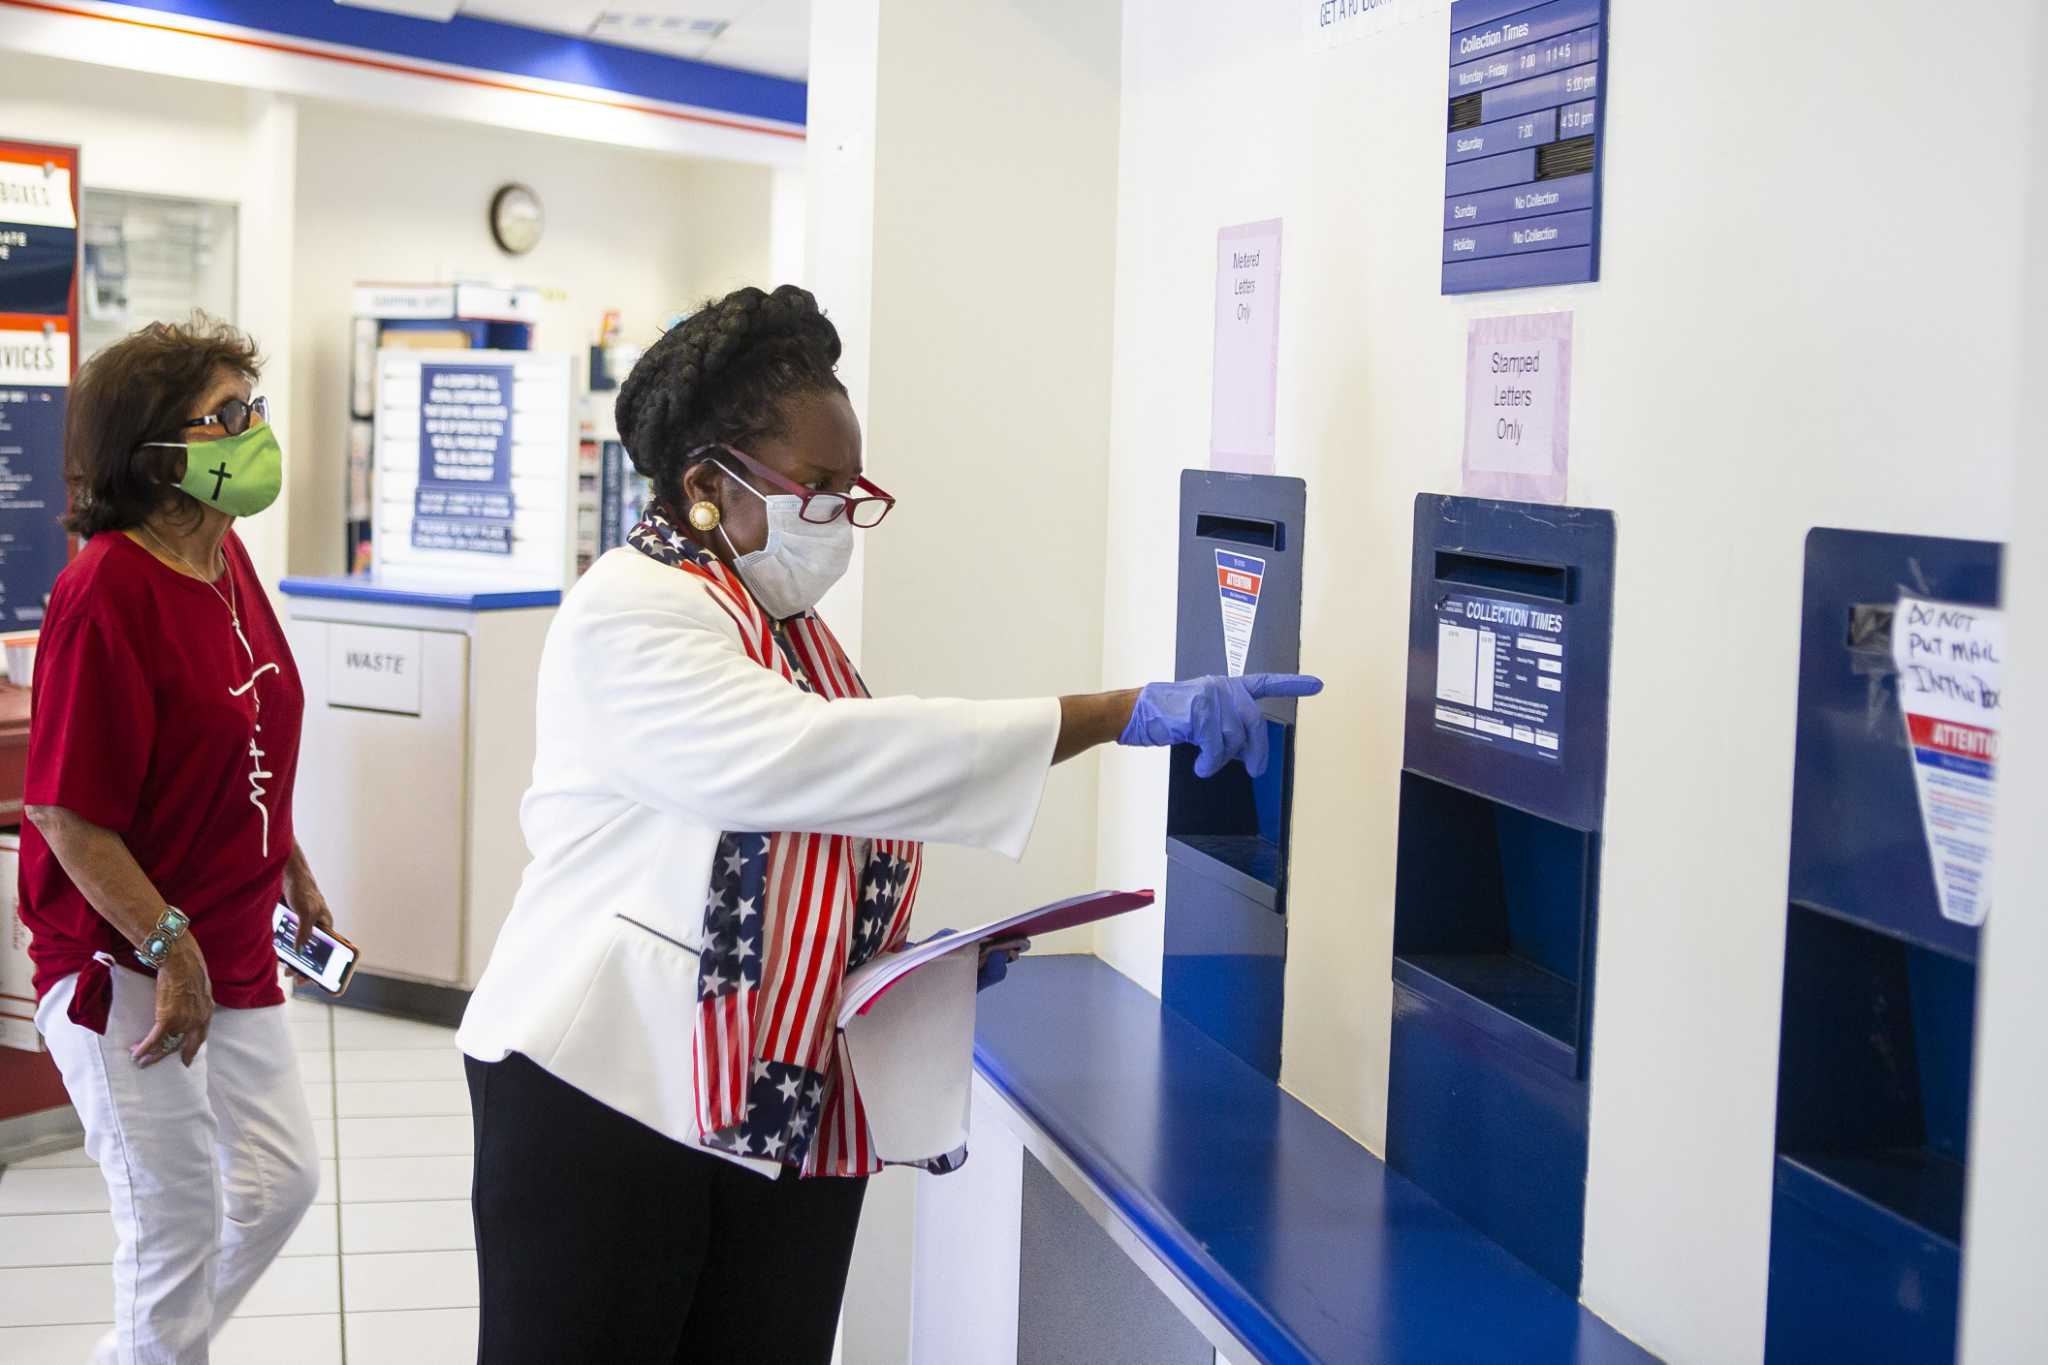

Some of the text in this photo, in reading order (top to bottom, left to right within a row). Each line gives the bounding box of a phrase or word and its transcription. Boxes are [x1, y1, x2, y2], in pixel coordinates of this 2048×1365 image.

[1320, 0, 1336, 27] GET
[1460, 23, 1529, 54] Collection Times
[1460, 68, 1484, 86] Monday
[1488, 62, 1509, 79] Friday
[1456, 137, 1485, 152] Saturday
[1454, 192, 1559, 219] Sunday No Collection
[1453, 227, 1558, 252] Holiday No Collection
[0, 346, 54, 370] VICES
[1492, 350, 1540, 377] Stamped
[1494, 385, 1532, 407] Letters
[1497, 417, 1523, 445] Only
[1466, 602, 1529, 627] COLLECTION
[1530, 611, 1563, 633] TIMES
[1908, 604, 1977, 632] DO NOT
[346, 652, 406, 674] WASTE
